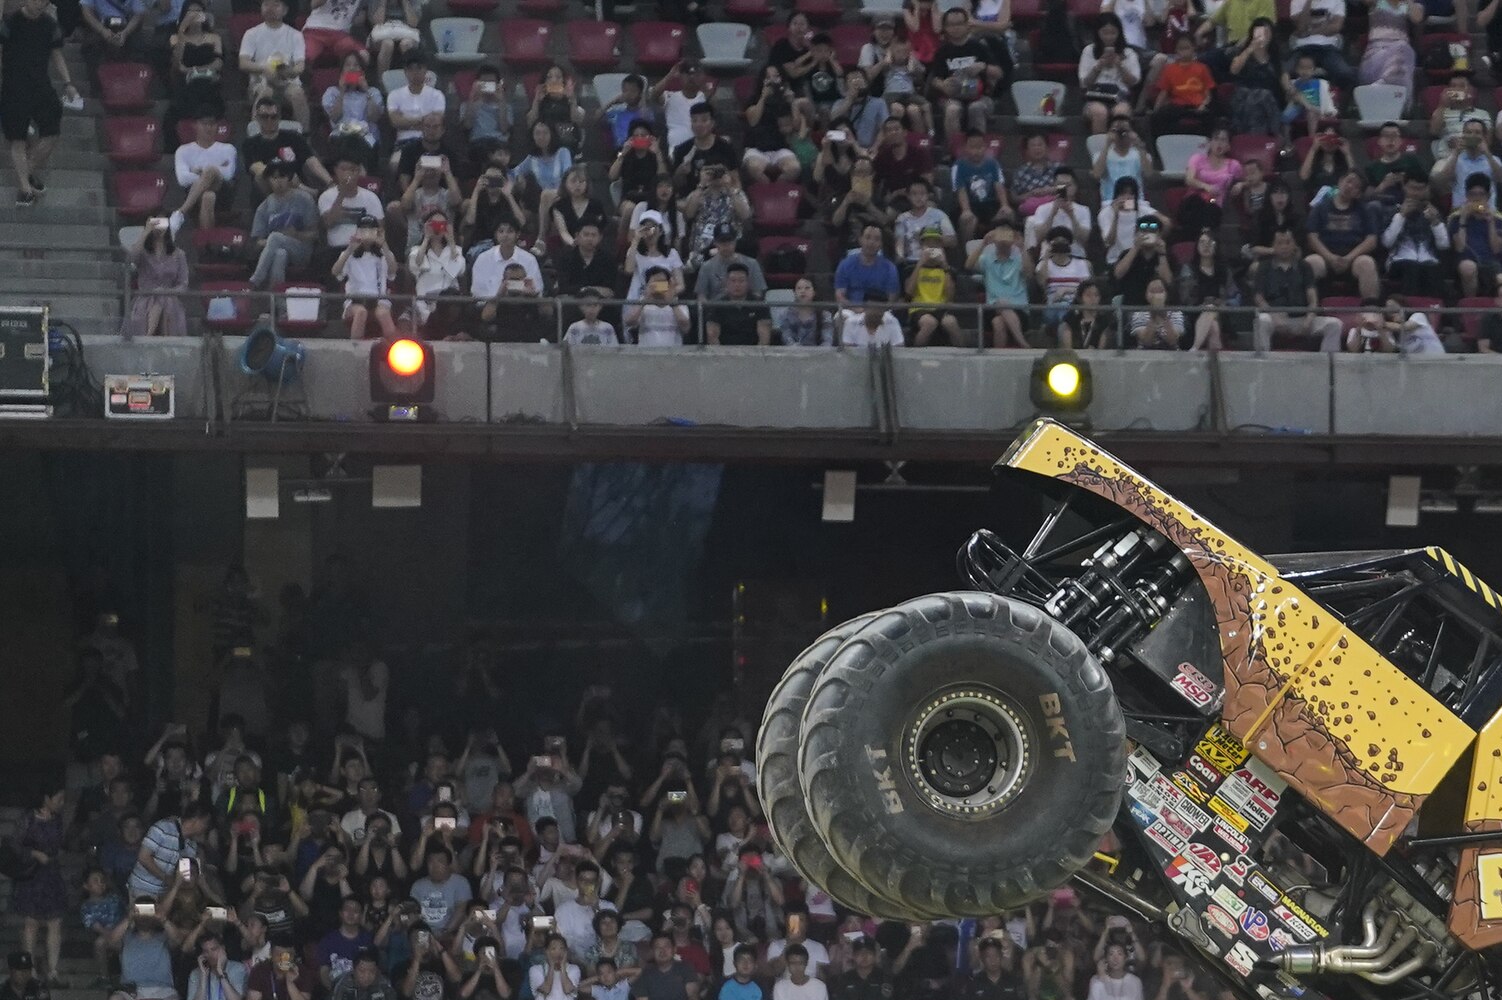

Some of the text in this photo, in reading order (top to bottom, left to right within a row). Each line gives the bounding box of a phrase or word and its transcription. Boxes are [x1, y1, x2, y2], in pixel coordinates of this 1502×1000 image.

[1175, 675, 1210, 702] MSD
[1038, 692, 1077, 763] BKT
[1221, 731, 1244, 752] Auto
[1217, 739, 1243, 760] Meter
[864, 744, 904, 814] BKT
[1189, 755, 1218, 783] Coan
[1235, 769, 1280, 802] ARP
[1180, 798, 1210, 826] CROWER
[1245, 800, 1270, 824] Holley
[1153, 821, 1186, 849] OPTIMA
[1215, 816, 1247, 844] LINCOLN
[1189, 843, 1220, 873] JAZ
[1282, 895, 1329, 938] MAGNAFLOW
